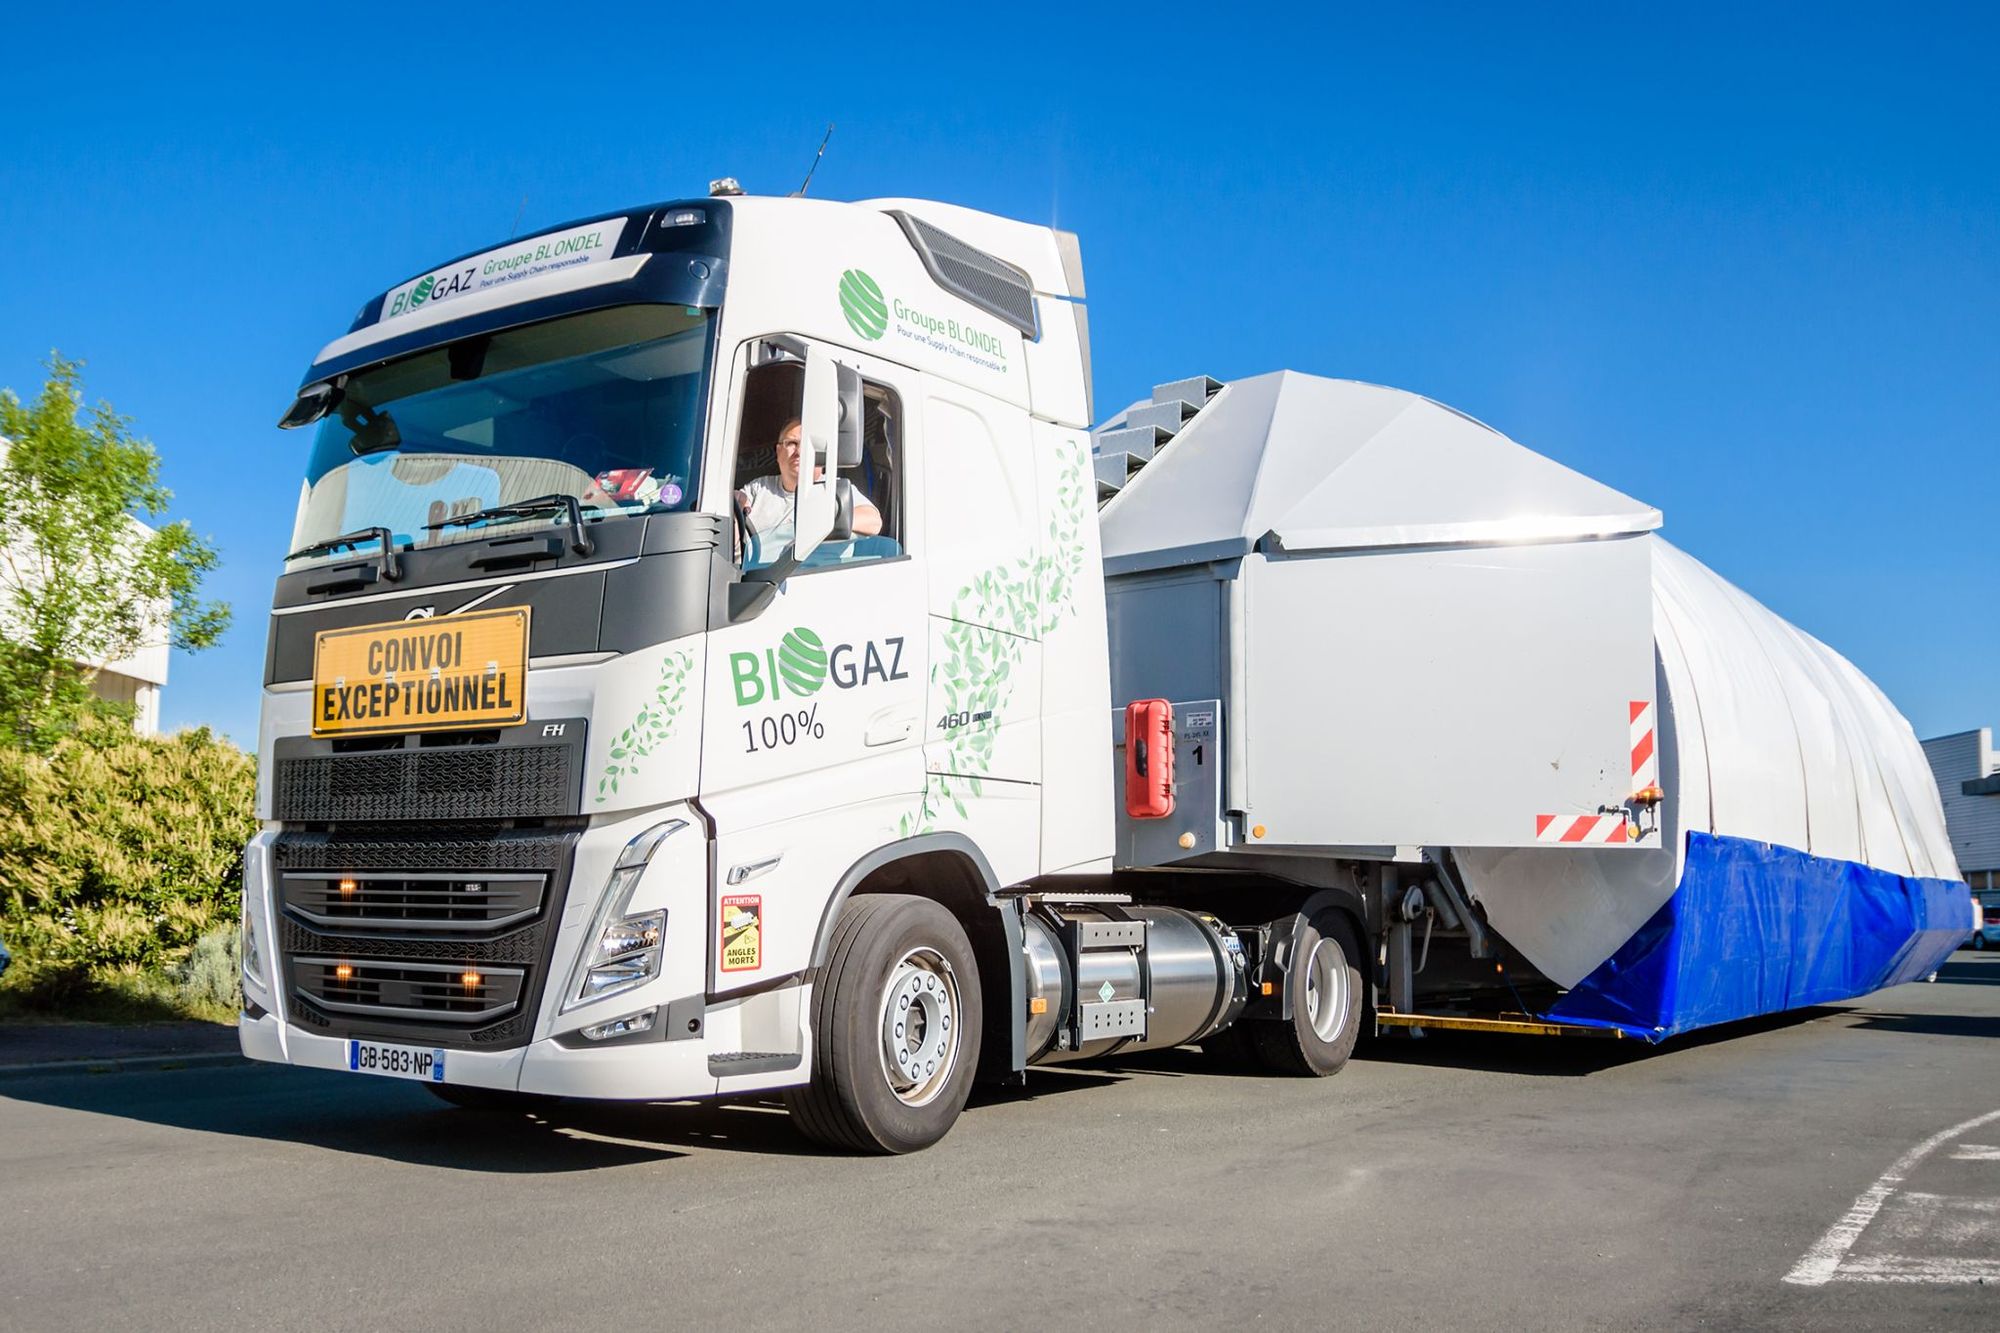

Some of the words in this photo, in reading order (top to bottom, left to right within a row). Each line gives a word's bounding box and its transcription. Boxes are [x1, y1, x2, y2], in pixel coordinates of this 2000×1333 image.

[483, 252, 532, 275] Groupe
[535, 232, 603, 261] BLONDEL
[893, 298, 945, 335] Groupe
[947, 319, 1007, 360] BLONDEL
[897, 324, 913, 338] Pour
[926, 335, 948, 352] Supply
[368, 631, 462, 675] CONVOI
[323, 672, 513, 721] EXCEPTIONNEL
[542, 723, 566, 737] FH
[742, 702, 825, 753] 100%
[936, 711, 970, 730] 460
[1192, 745, 1203, 765] 1
[723, 896, 760, 905] ATTENTION
[727, 947, 756, 957] ANGLES
[728, 956, 755, 965] MORTS
[360, 1046, 433, 1075] GB-583-NP
